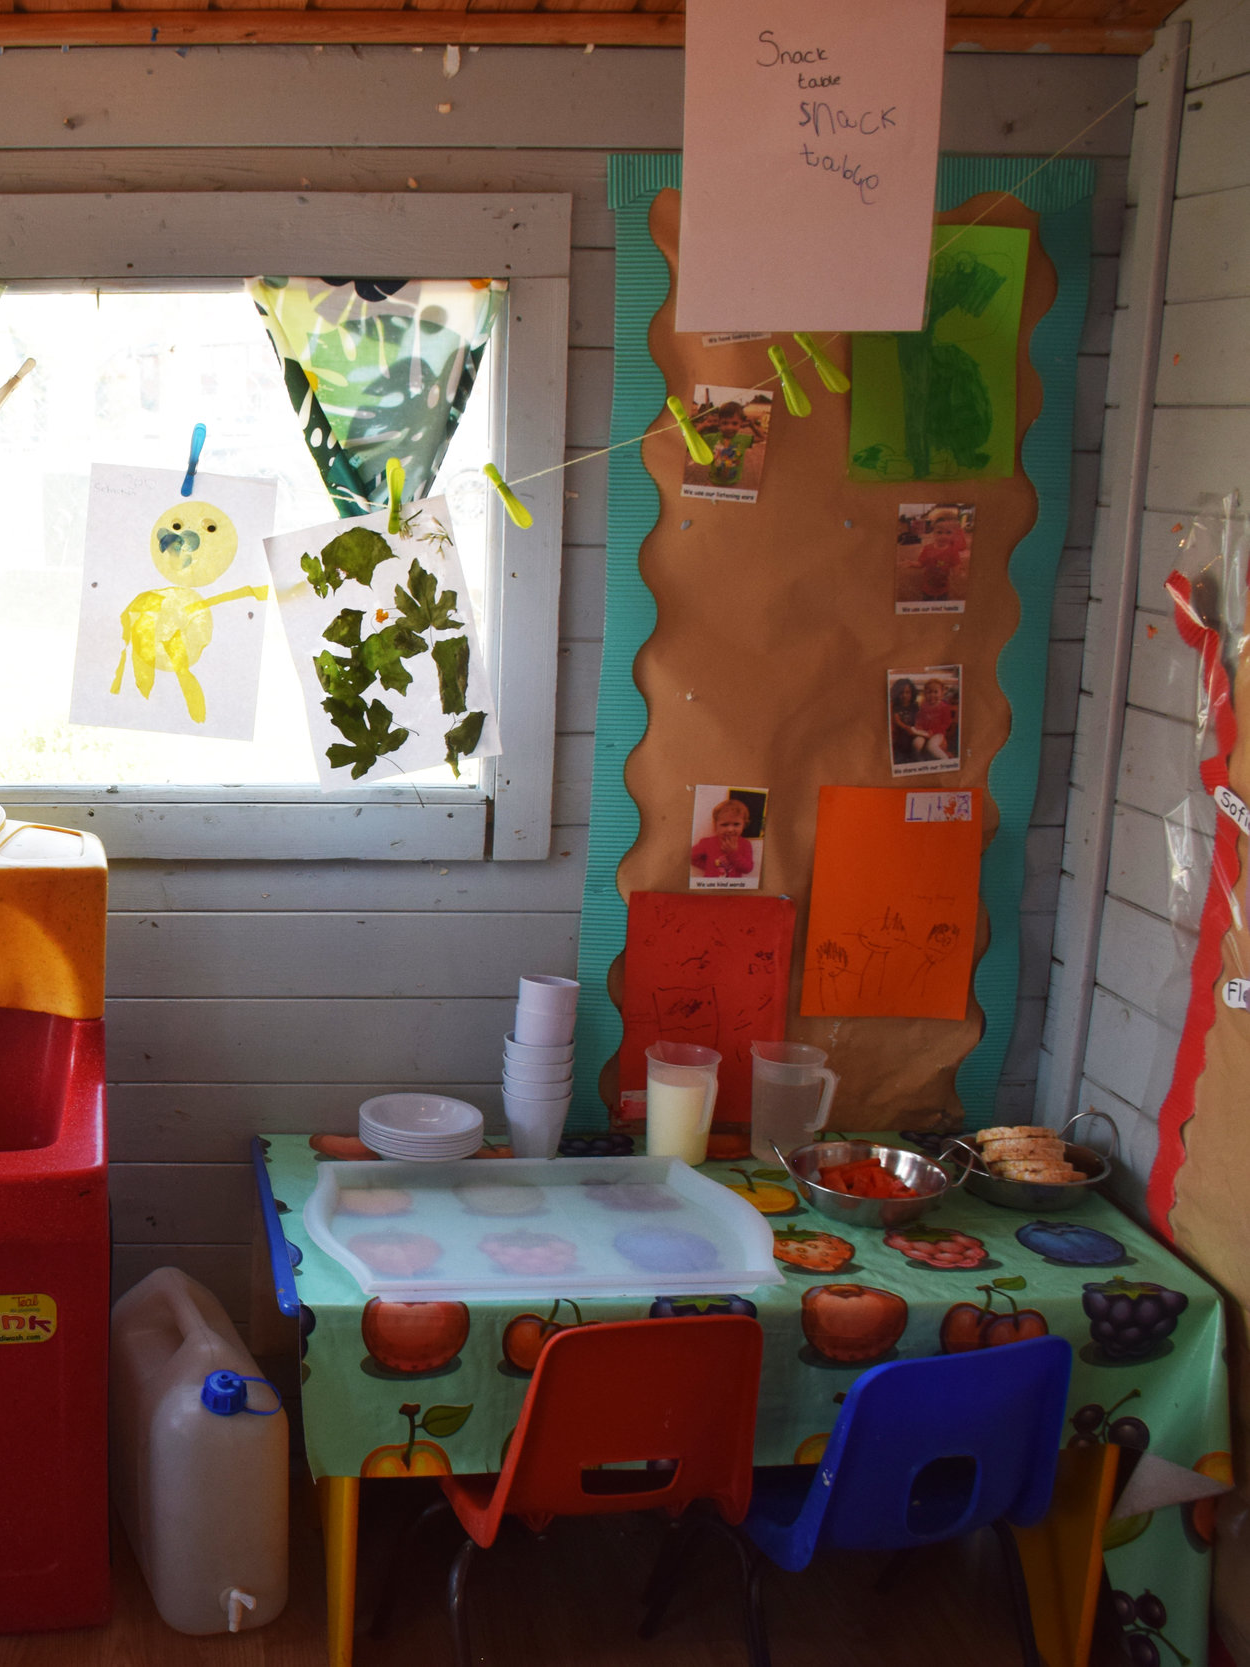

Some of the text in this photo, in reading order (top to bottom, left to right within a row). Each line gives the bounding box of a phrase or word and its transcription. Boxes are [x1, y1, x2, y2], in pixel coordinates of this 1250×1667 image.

[756, 30, 829, 67] Snack
[798, 73, 841, 89] table
[1220, 791, 1250, 830] Sofi
